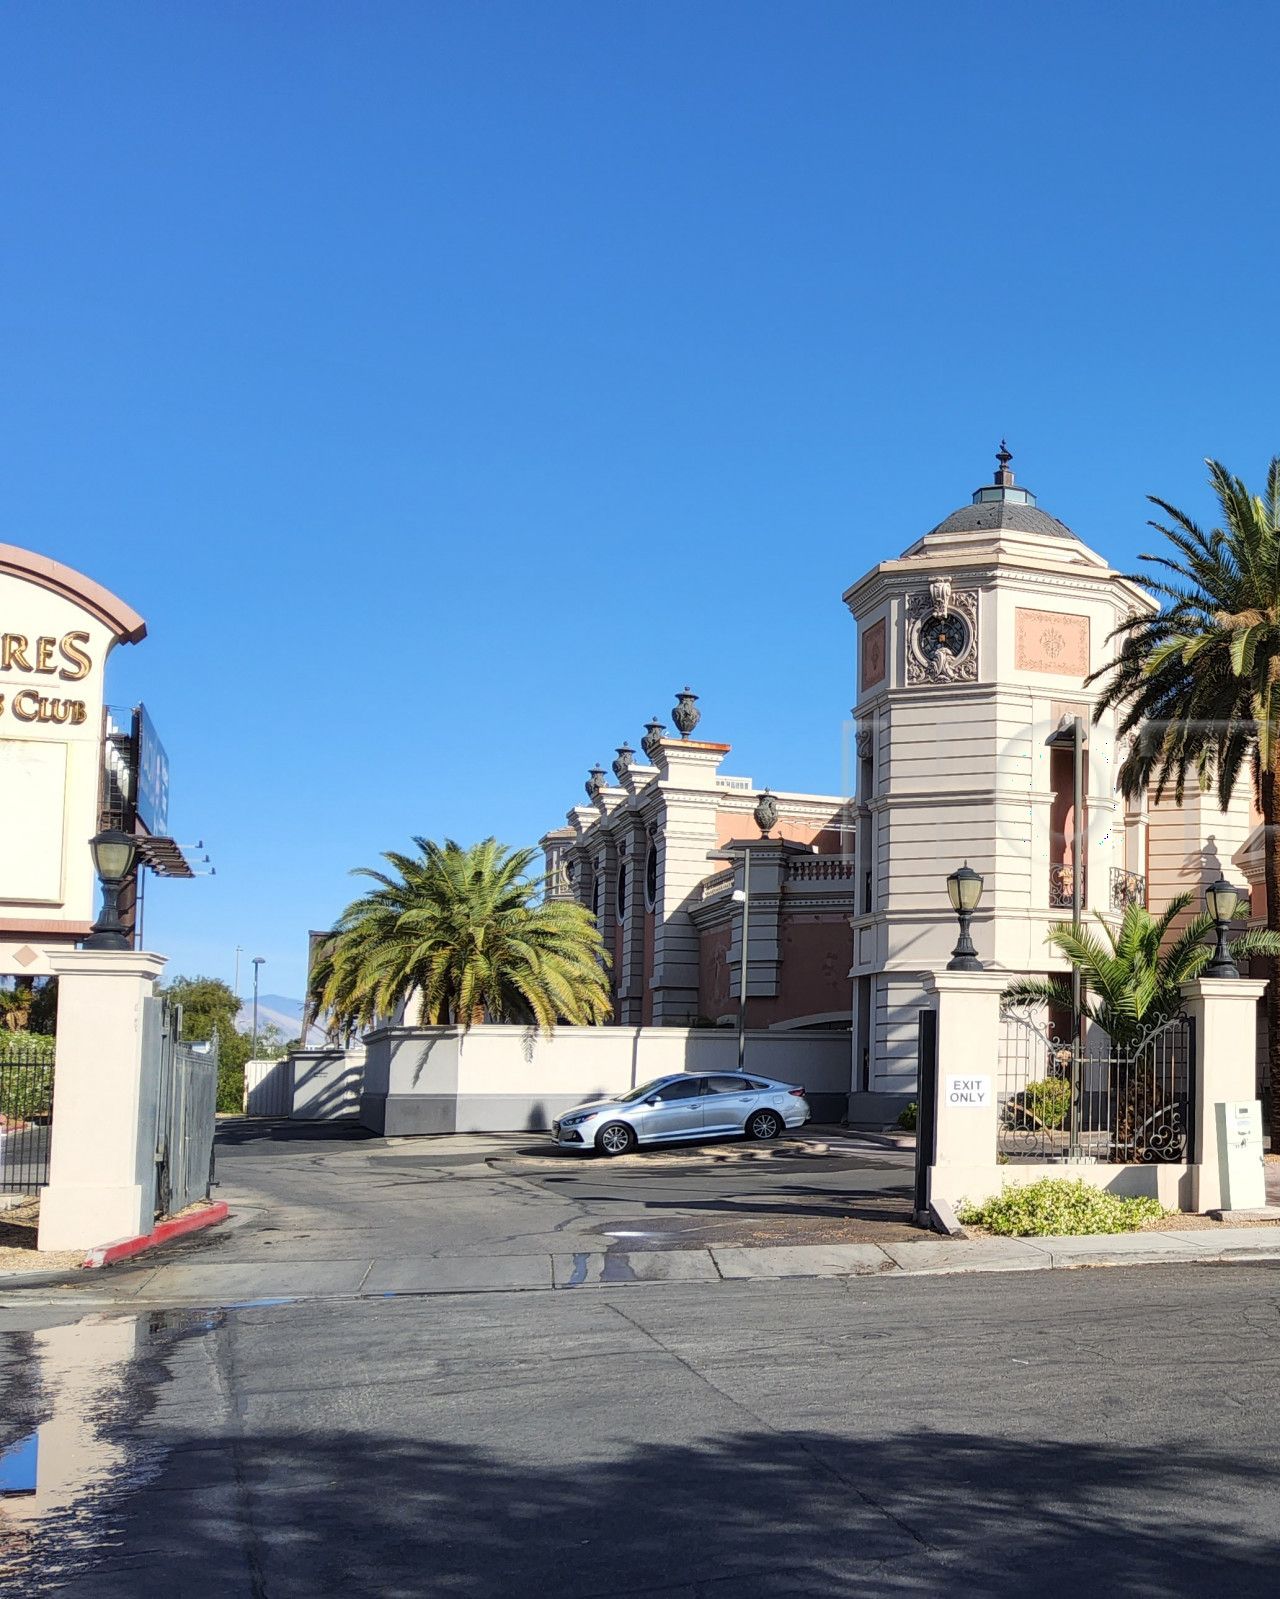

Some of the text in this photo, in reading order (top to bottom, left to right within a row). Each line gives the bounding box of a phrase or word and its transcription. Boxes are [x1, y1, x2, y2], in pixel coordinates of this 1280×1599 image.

[11, 689, 87, 725] CLUB
[953, 1080, 983, 1091] EXIT
[950, 1092, 985, 1103] ONLY
